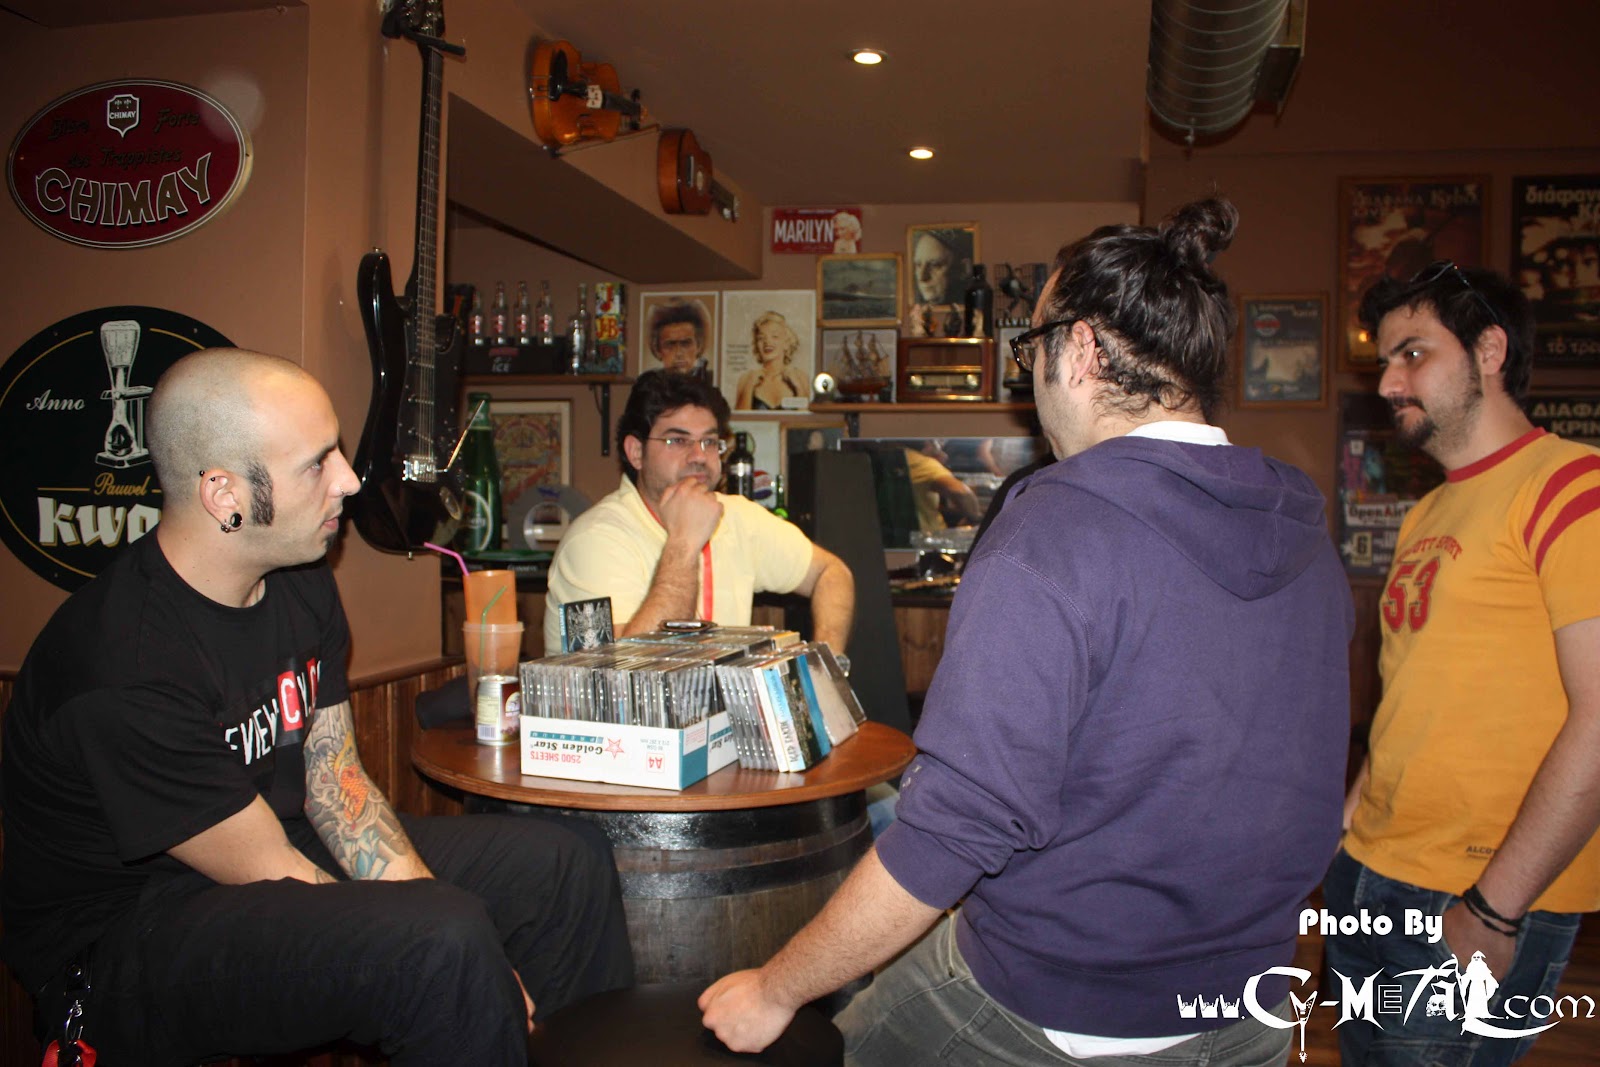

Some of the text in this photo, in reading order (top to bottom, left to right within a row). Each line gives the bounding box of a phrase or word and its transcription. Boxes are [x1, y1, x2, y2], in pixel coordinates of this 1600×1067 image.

[109, 111, 137, 120] CHIMAY
[154, 108, 200, 134] Forte
[35, 152, 212, 226] CHIMAY
[1525, 184, 1600, 208] διάφαν
[774, 219, 834, 244] MARILYN
[998, 317, 1031, 327] ELVIS
[26, 389, 85, 411] Anno
[94, 472, 150, 496] Pauwel
[1381, 555, 1440, 634] 53
[530, 751, 582, 764] 2500 SHEETS
[534, 740, 603, 756] Golden Star
[648, 756, 663, 769] A4
[1466, 845, 1497, 855] ALCO
